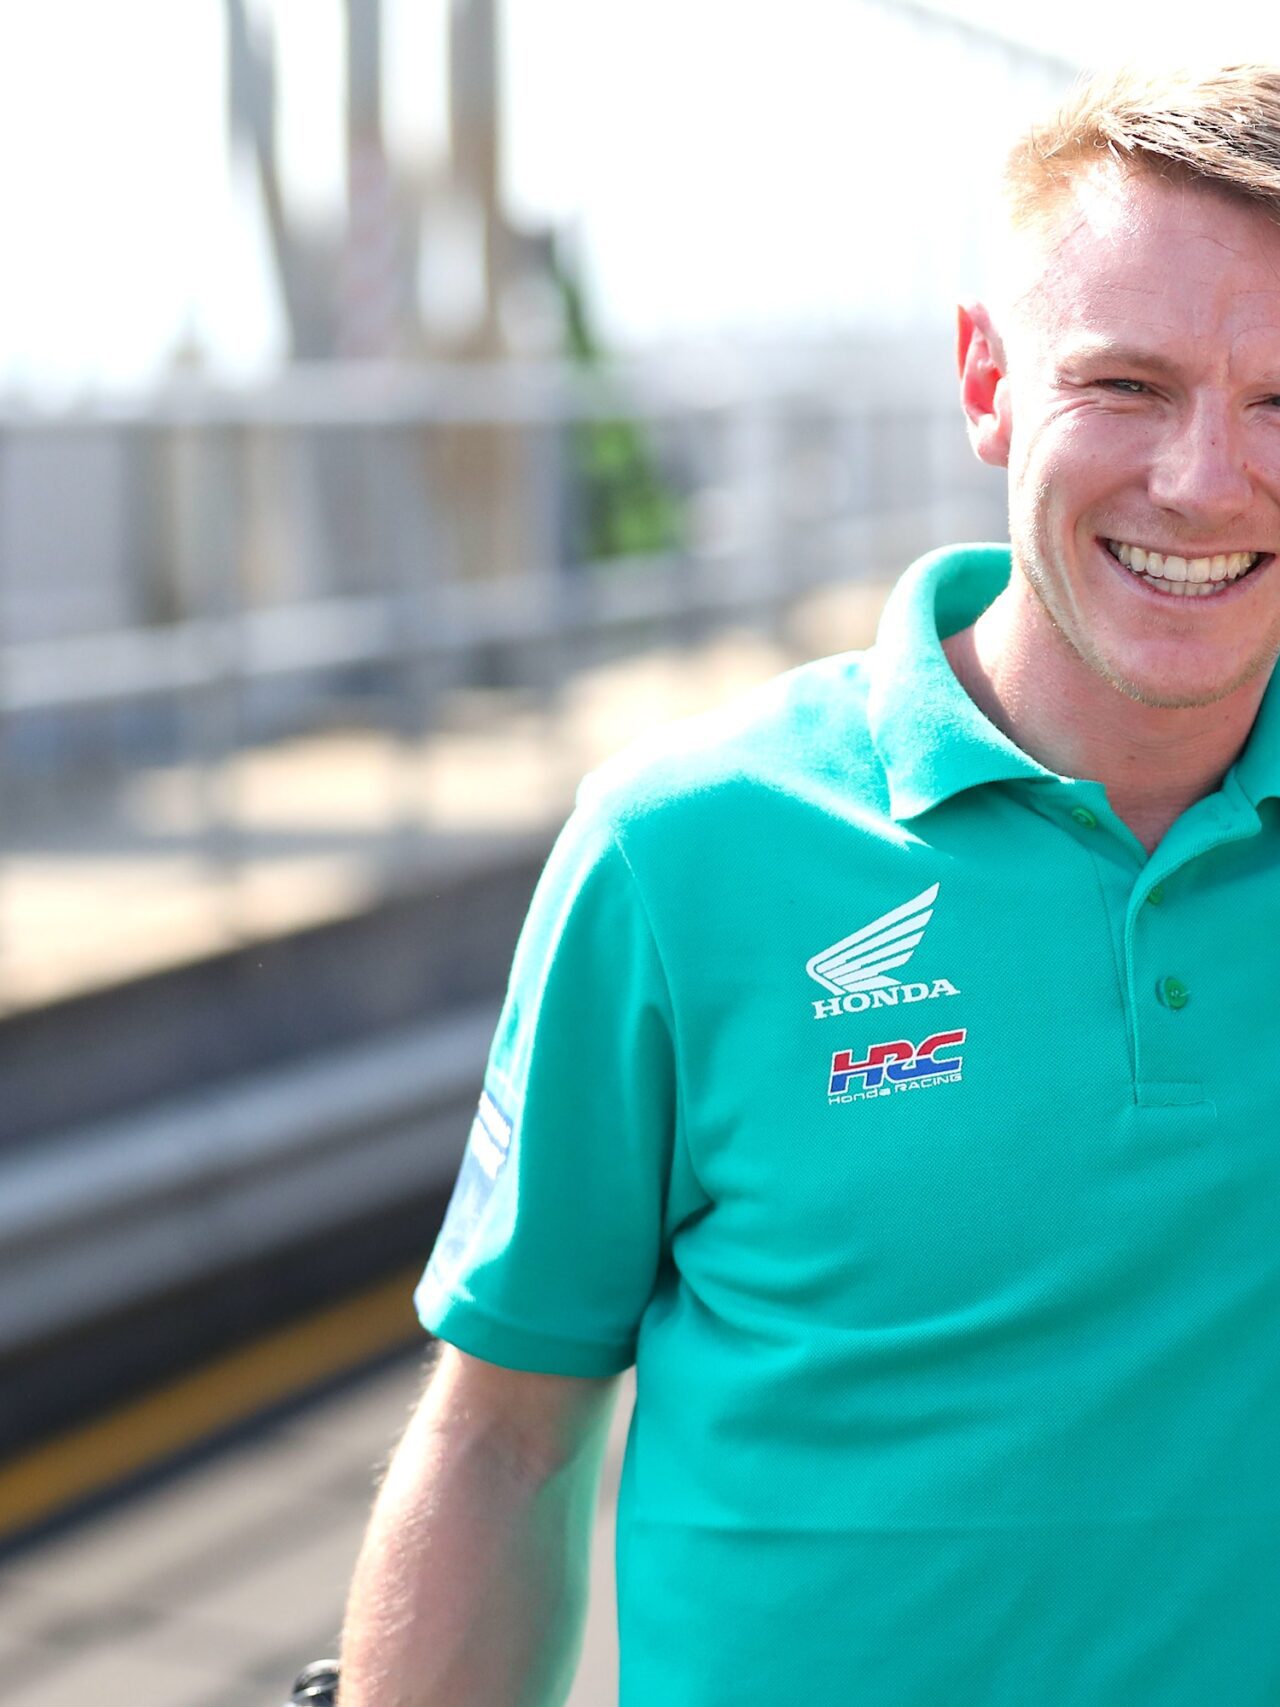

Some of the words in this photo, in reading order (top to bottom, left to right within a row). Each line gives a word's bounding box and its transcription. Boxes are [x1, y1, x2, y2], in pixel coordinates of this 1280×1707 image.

[812, 978, 961, 1020] HONDA
[827, 1028, 967, 1097] HRC
[828, 1087, 891, 1106] Honda
[894, 1072, 963, 1093] RACING
